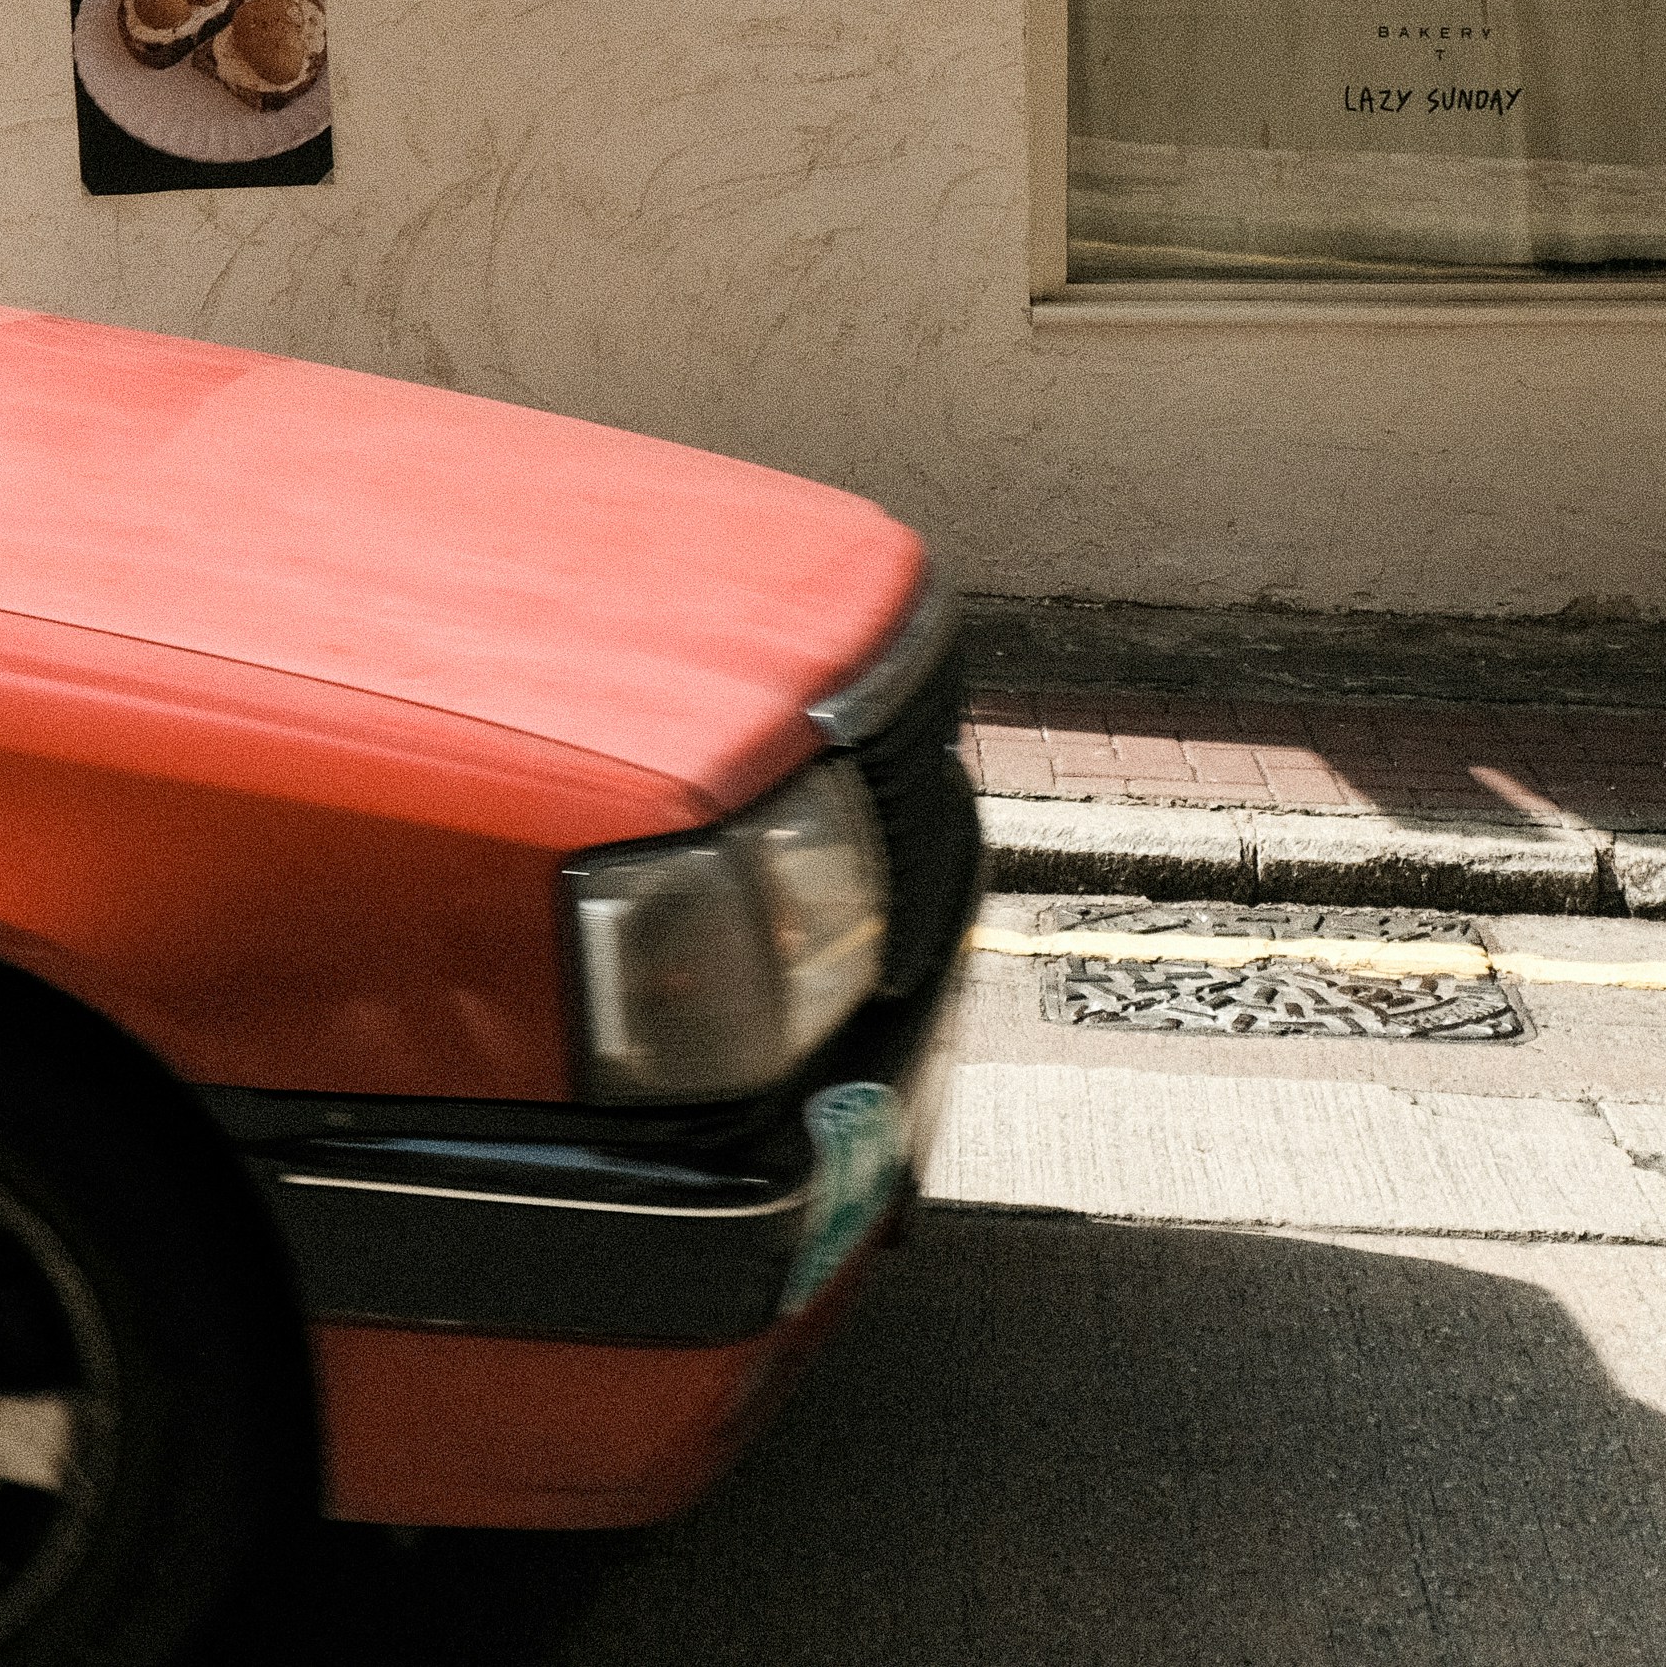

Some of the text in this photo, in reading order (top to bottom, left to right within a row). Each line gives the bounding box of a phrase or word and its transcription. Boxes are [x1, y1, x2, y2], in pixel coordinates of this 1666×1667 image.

[1377, 26, 1492, 40] BAKERY
[1344, 85, 1524, 116] LAZY SUNDAY
